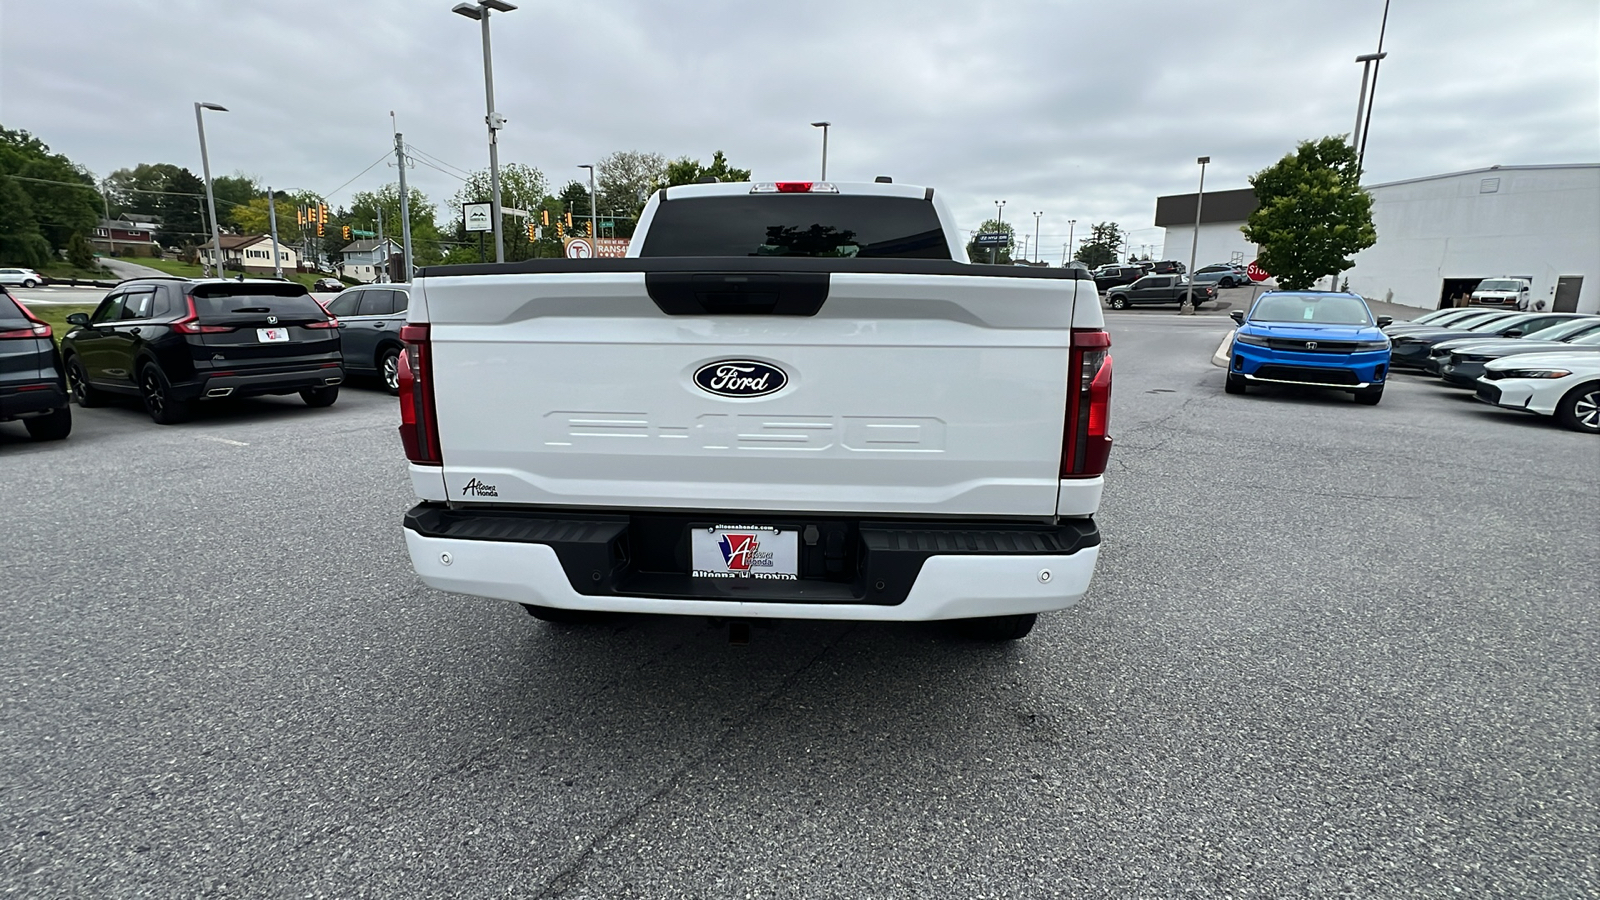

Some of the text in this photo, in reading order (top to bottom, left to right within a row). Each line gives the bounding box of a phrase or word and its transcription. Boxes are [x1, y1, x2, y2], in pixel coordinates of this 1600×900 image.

[1248, 265, 1268, 275] STO
[709, 366, 768, 393] Ford
[543, 411, 947, 453] F-150
[462, 477, 496, 496] Altoona
[728, 537, 773, 566] Altoona
[745, 558, 774, 567] Honda
[692, 570, 735, 578] Altoona
